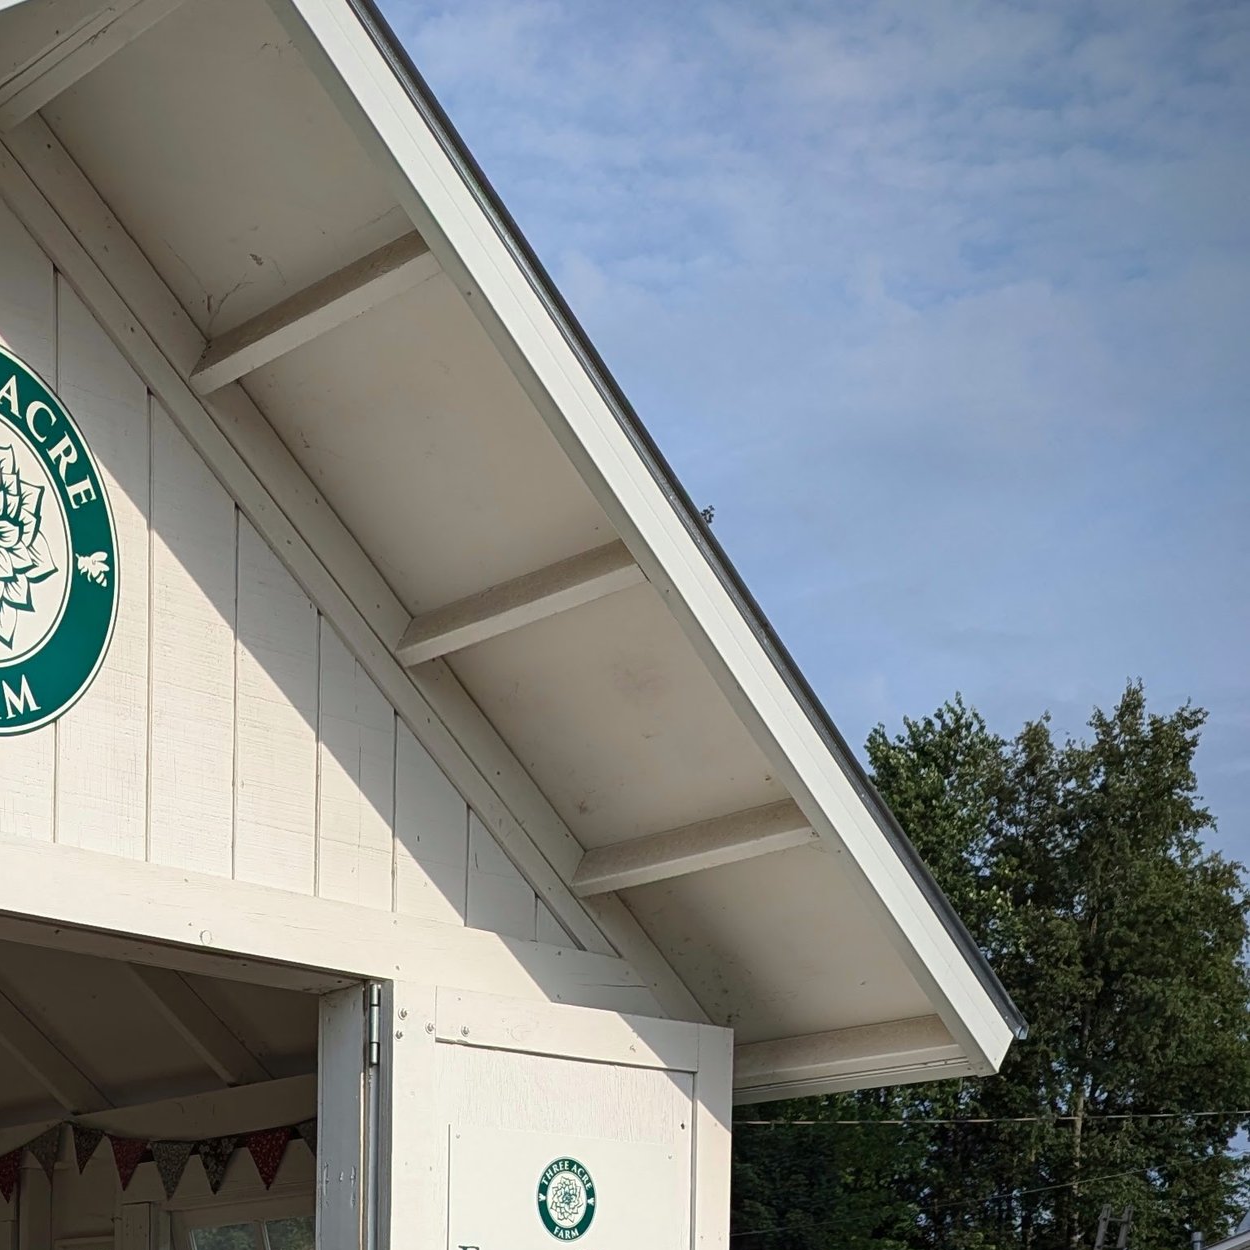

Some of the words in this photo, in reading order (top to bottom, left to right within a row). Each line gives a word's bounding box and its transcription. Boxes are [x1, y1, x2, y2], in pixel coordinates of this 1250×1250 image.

[541, 1160, 570, 1186] THREE
[570, 1162, 594, 1191] ACRE
[553, 1226, 580, 1241] FARM
